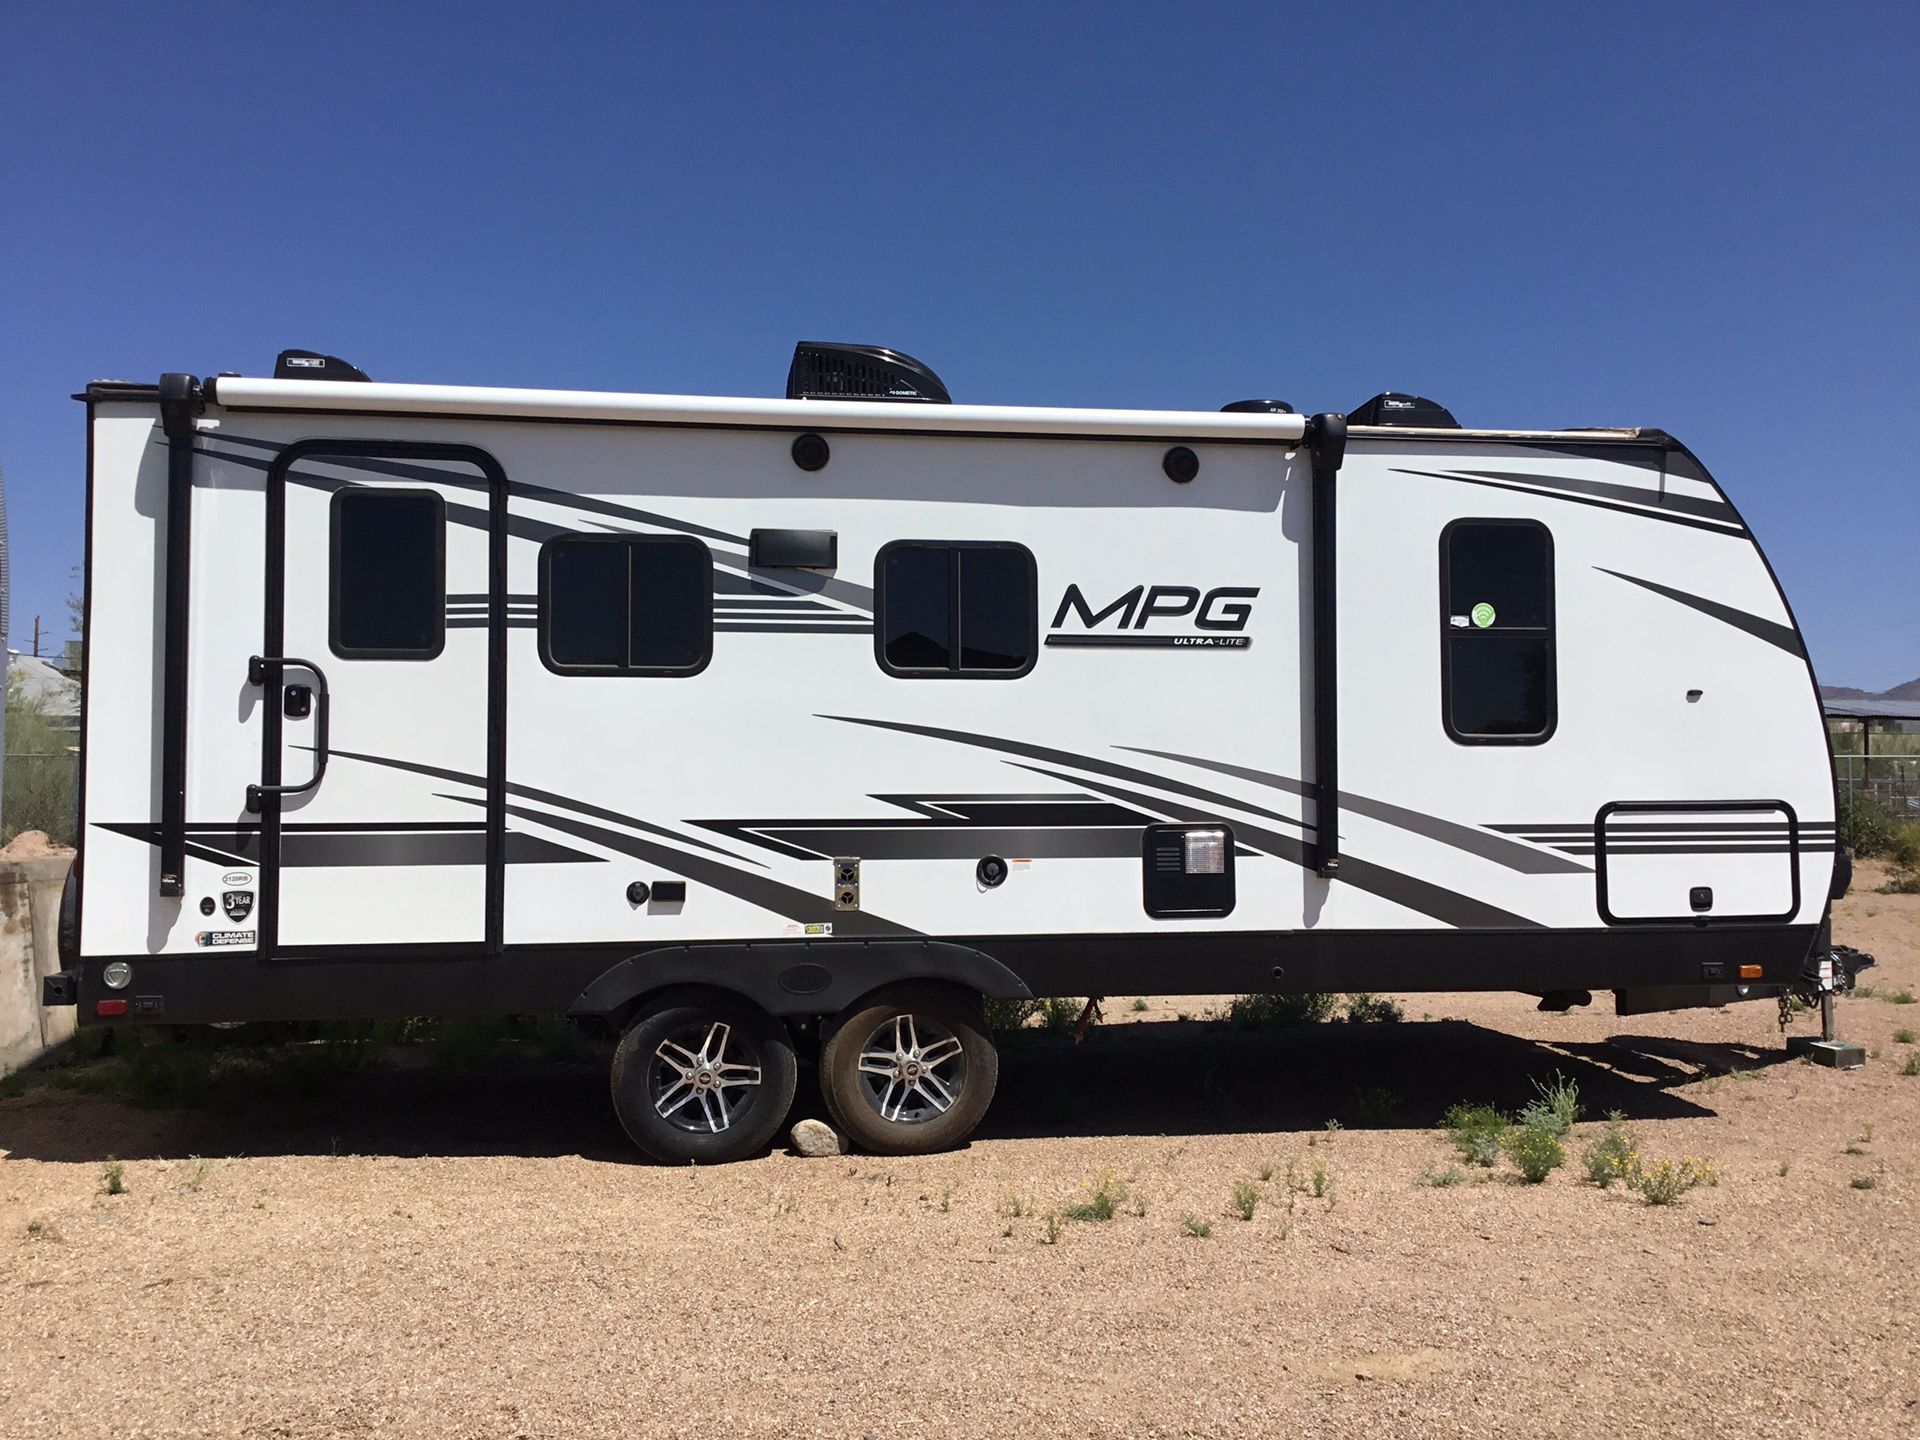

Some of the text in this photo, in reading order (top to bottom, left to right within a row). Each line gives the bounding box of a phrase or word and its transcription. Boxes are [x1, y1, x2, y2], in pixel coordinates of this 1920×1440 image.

[1050, 583, 1261, 631] MPG
[1174, 637, 1245, 646] ULTRA-LITE
[226, 893, 235, 909] 3
[235, 896, 251, 905] YEAR
